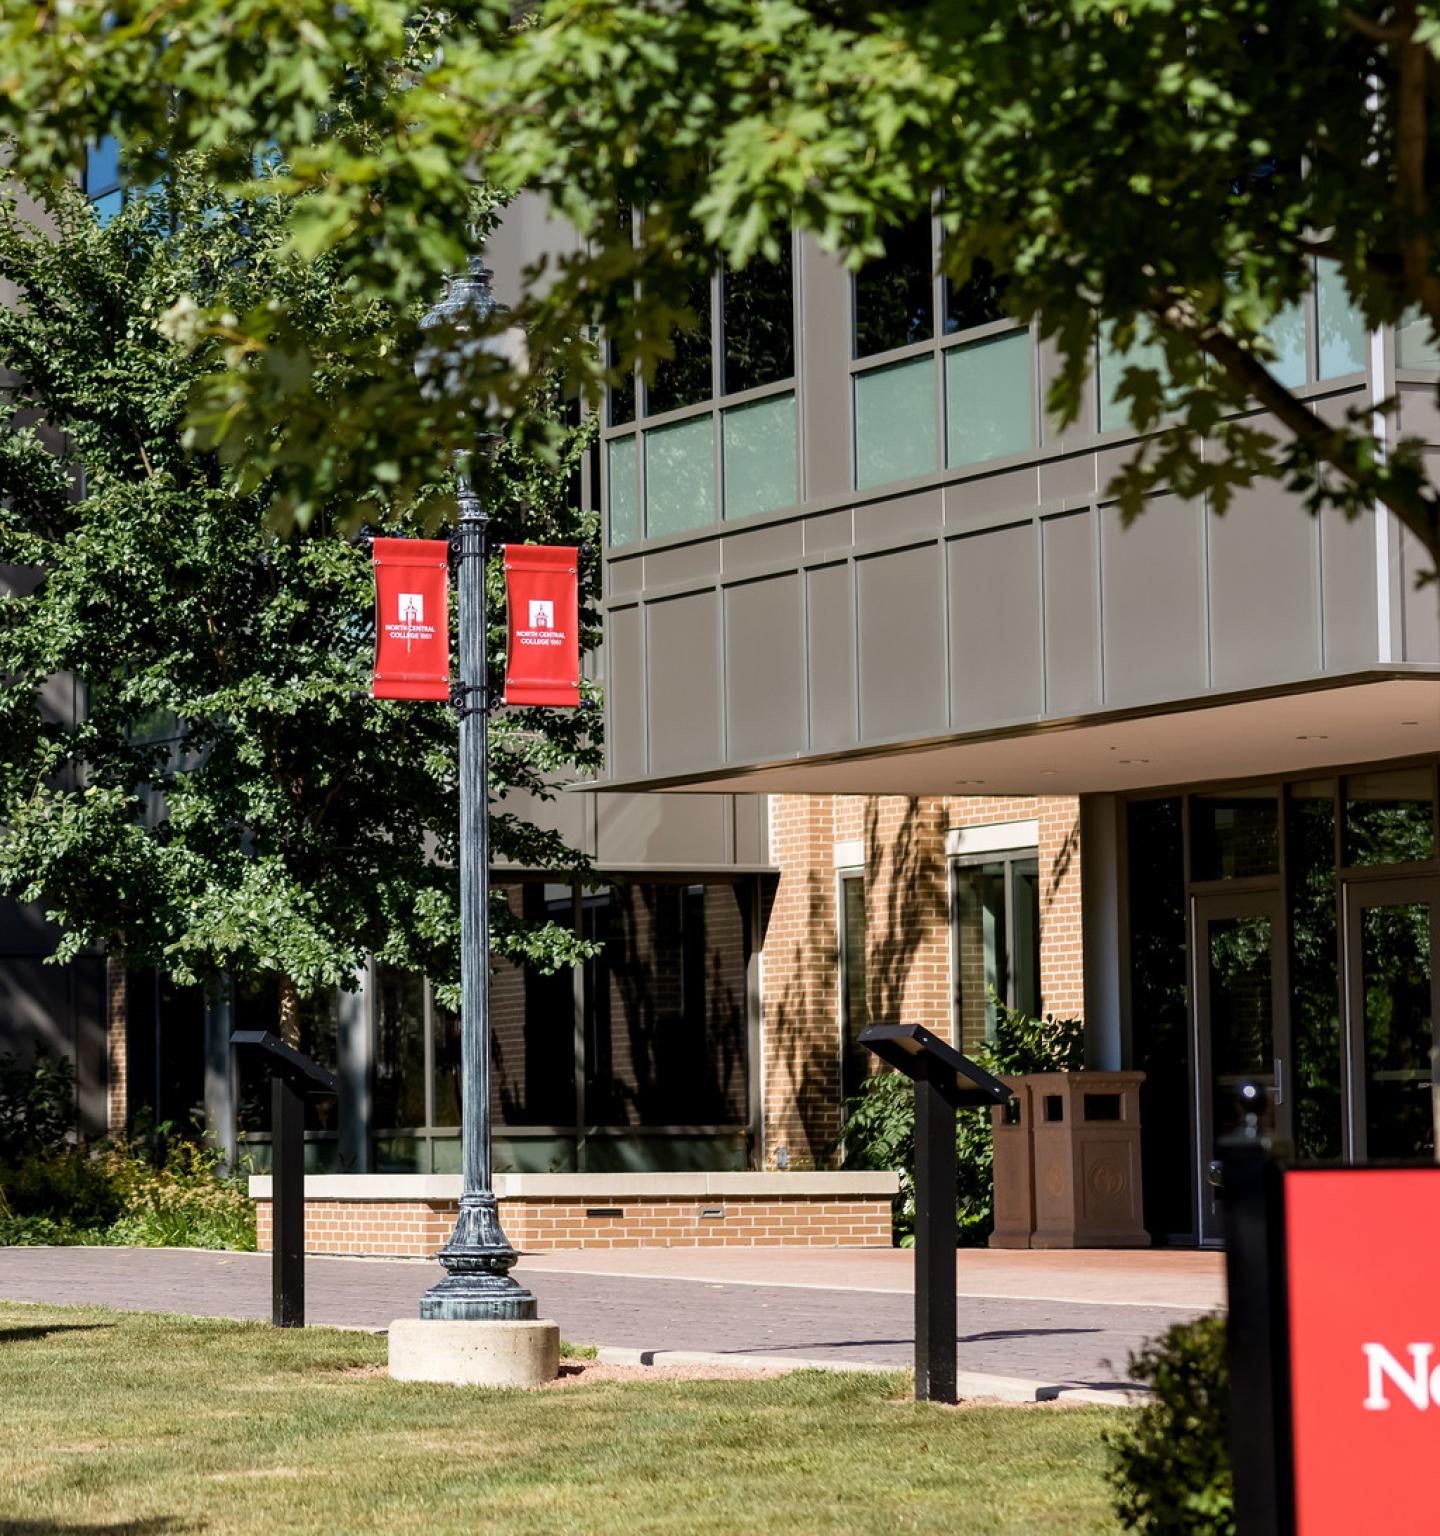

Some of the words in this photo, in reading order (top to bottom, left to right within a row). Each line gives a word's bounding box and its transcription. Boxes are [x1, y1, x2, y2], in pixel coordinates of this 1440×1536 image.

[539, 631, 566, 639] CENTRAL
[521, 638, 549, 646] COLLEGE
[1361, 1342, 1440, 1412] N
